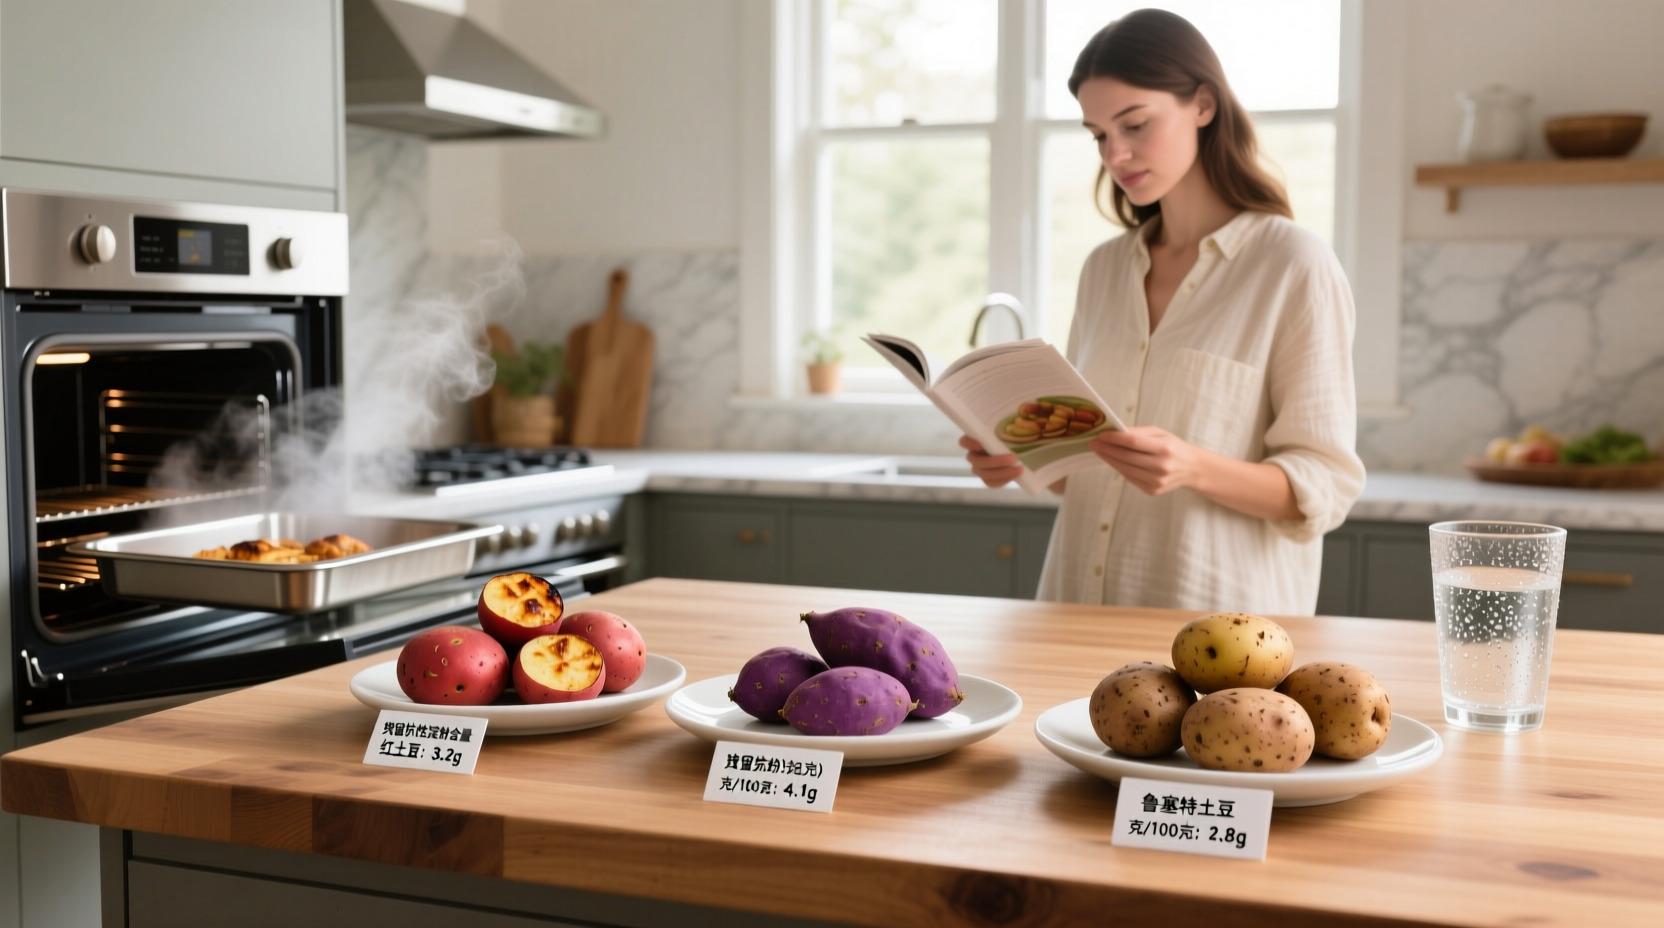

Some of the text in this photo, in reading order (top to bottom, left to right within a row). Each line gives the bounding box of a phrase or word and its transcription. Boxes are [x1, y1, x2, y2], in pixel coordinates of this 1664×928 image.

[431, 746, 463, 767] 3.2g
[783, 782, 818, 804] 4.1g
[1140, 792, 1236, 818] 鲁塞特土豆
[1208, 825, 1247, 849] 2.8g
